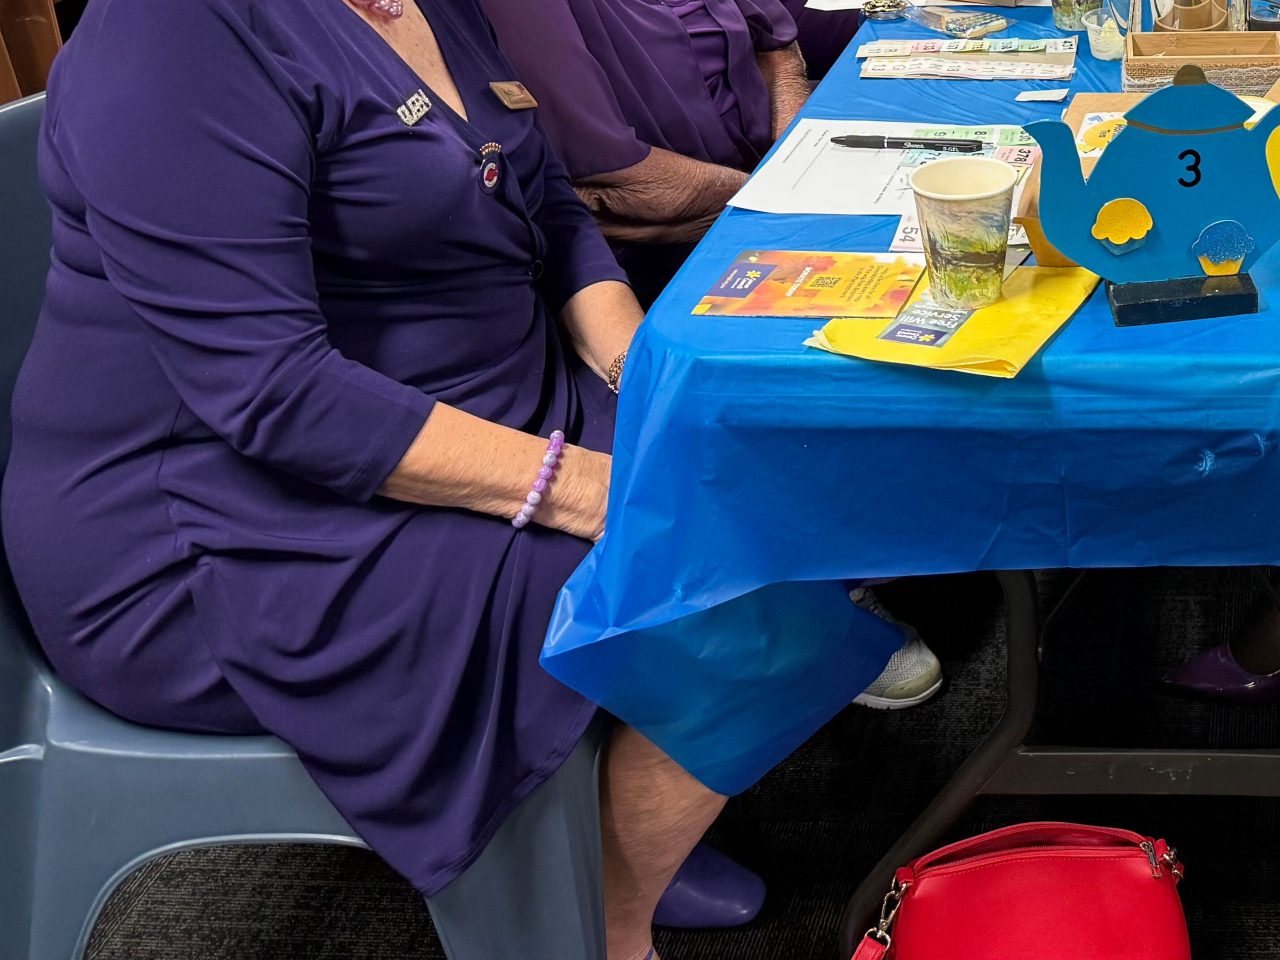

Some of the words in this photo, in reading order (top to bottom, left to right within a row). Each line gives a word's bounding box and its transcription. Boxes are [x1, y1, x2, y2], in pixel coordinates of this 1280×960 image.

[1014, 148, 1031, 163] 378
[1178, 149, 1202, 188] 3
[902, 227, 919, 243] 54
[900, 314, 925, 324] Will
[911, 309, 961, 321] Service
[928, 318, 958, 329] Free
